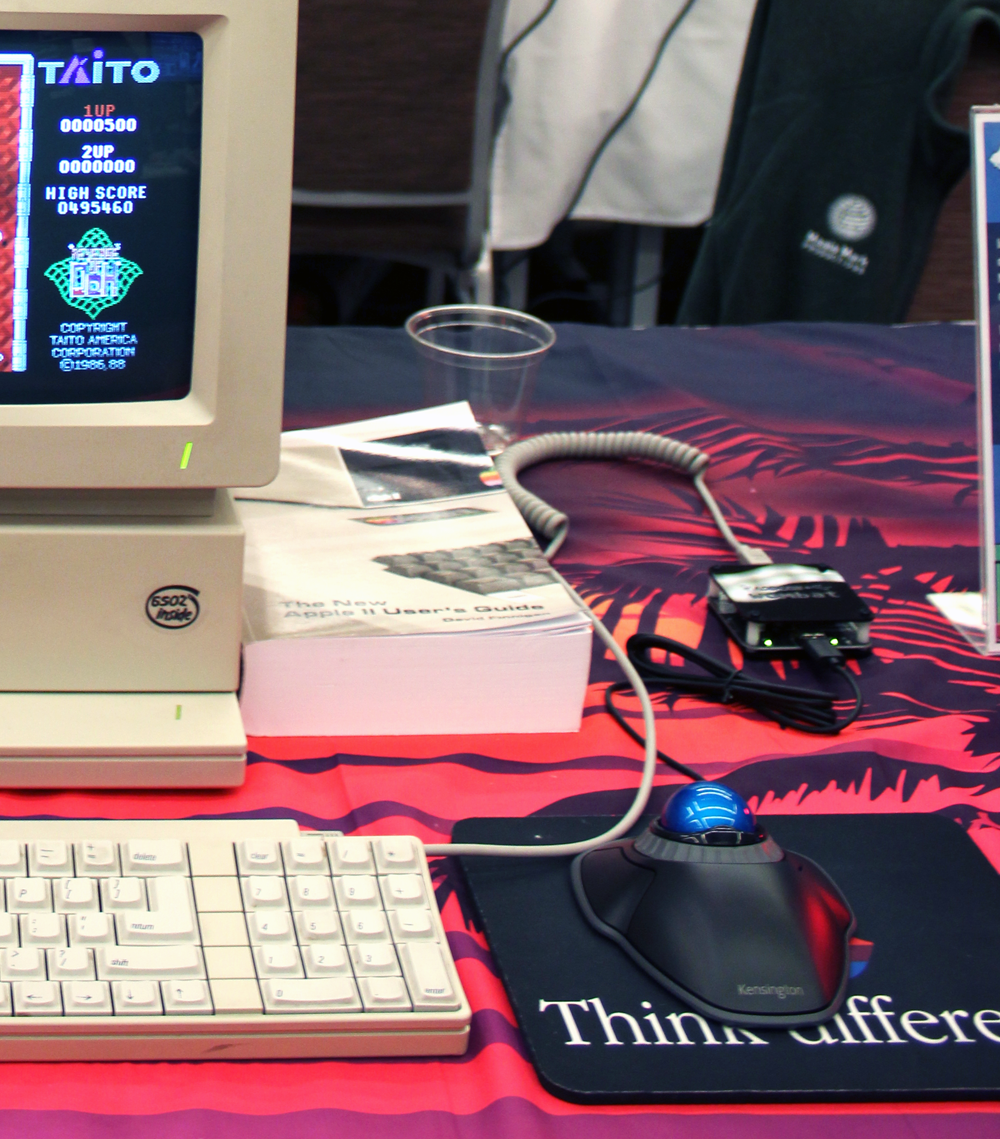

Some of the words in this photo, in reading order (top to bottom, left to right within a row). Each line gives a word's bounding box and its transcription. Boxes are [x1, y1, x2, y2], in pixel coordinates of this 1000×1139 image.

[38, 50, 161, 84] TAITO
[84, 105, 115, 117] 1UP
[60, 118, 138, 133] 0000500
[82, 145, 115, 159] 2UP
[58, 159, 137, 174] 0000000
[45, 186, 90, 200] HIGH
[95, 186, 147, 199] SCORE
[57, 201, 134, 214] 0495460
[49, 334, 85, 346] TAITO
[87, 334, 138, 345] AMERICA
[51, 347, 136, 358] CORPORATION
[151, 595, 188, 607] 6502
[280, 600, 325, 609] The
[332, 599, 388, 608] New
[283, 608, 356, 620] Apple
[383, 606, 467, 616] User's
[474, 604, 546, 613] Guide
[18, 889, 28, 899] P
[738, 984, 804, 1000] Kensington
